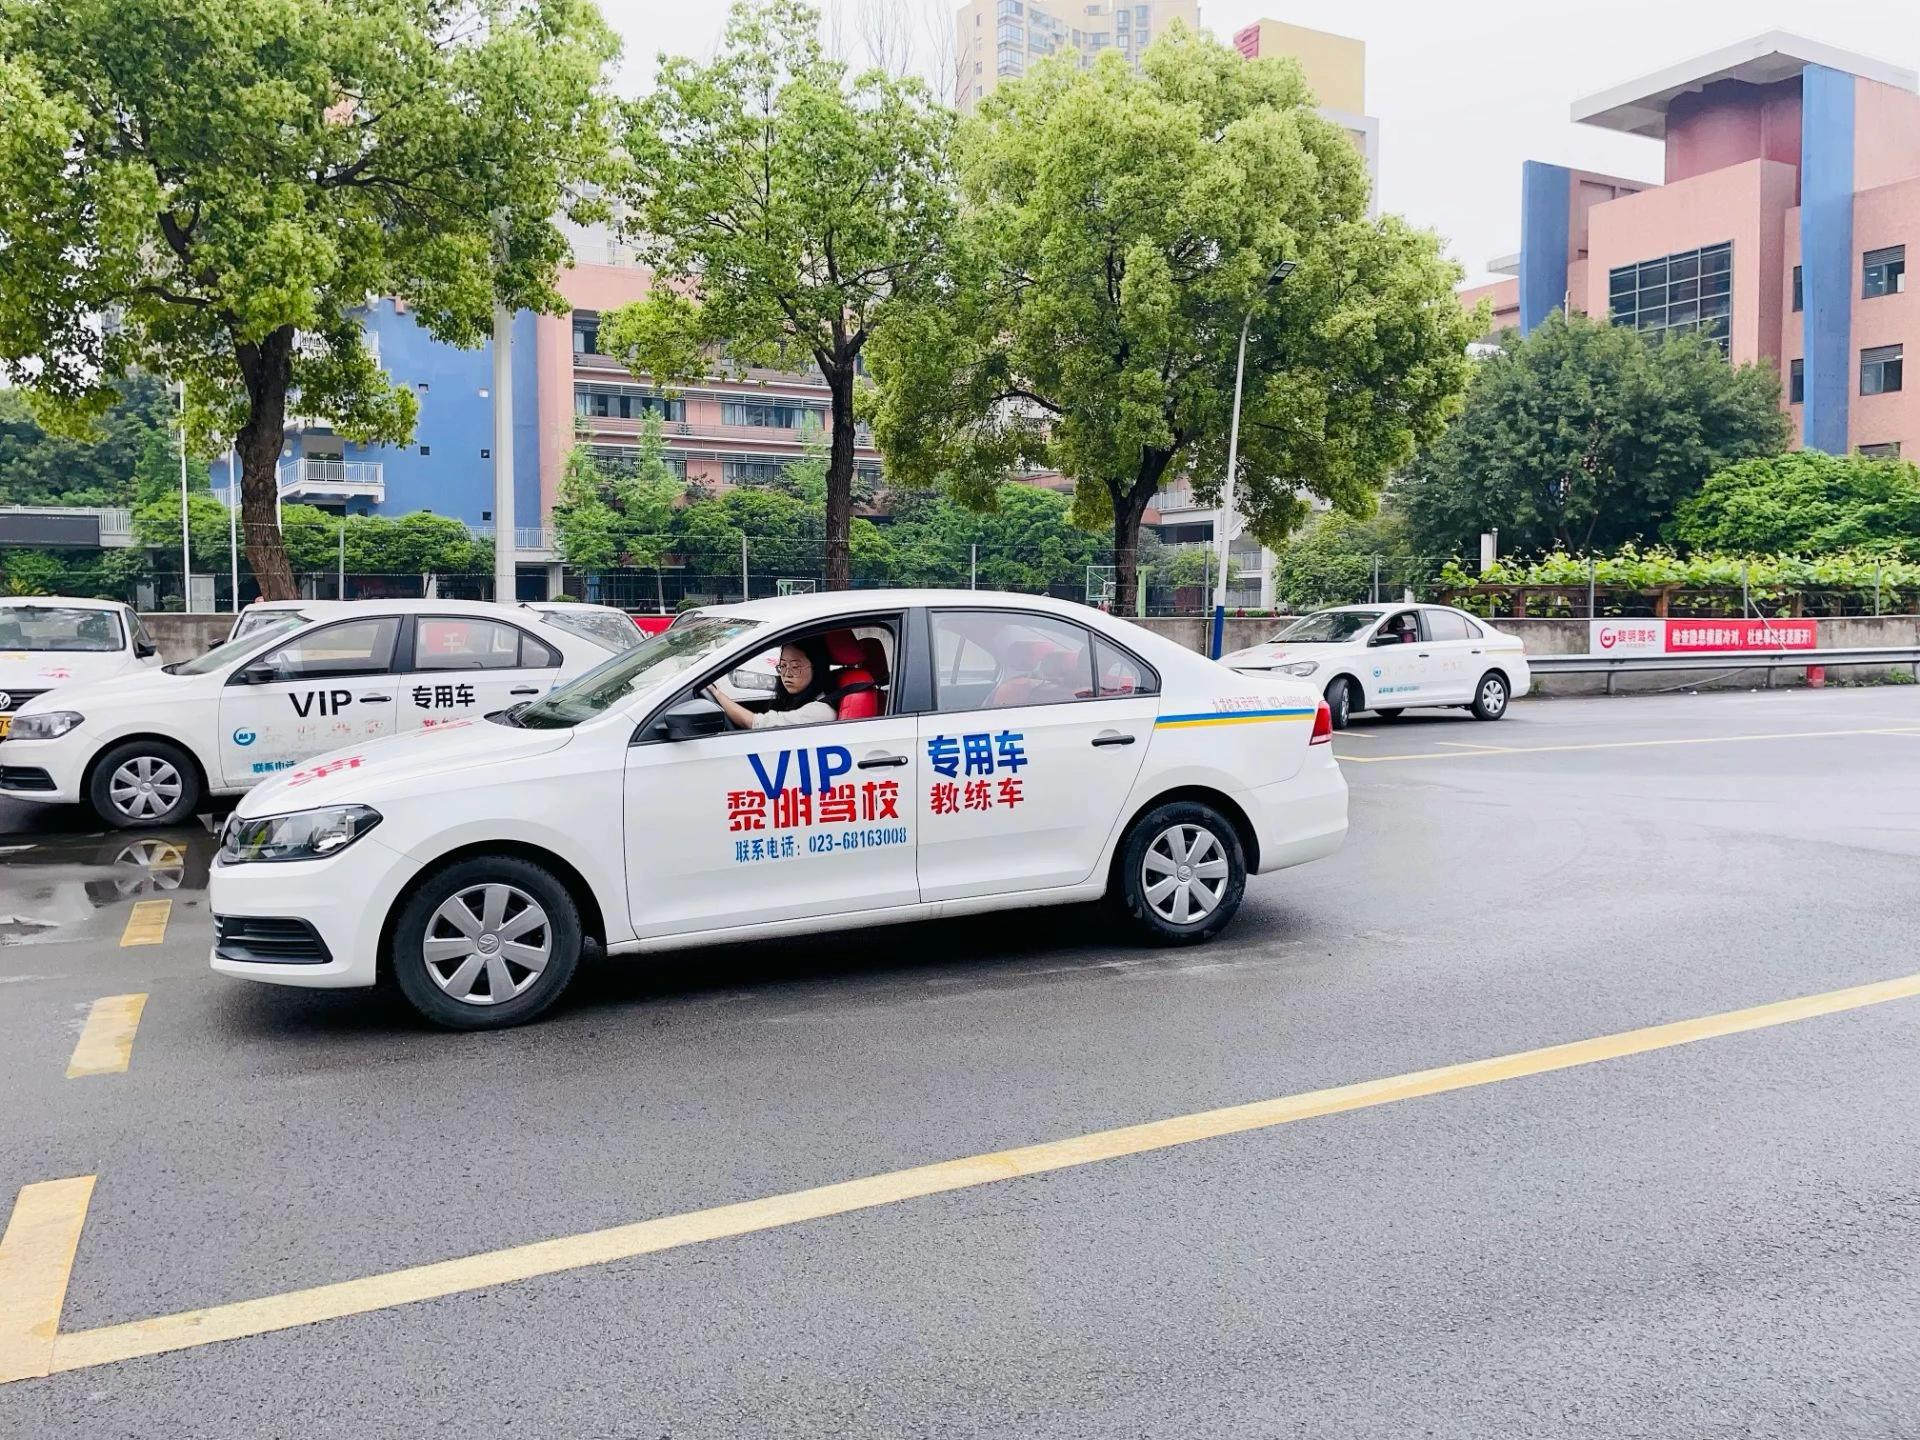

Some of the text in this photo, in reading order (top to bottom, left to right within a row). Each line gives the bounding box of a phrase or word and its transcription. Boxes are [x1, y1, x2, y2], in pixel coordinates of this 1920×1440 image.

[289, 684, 475, 717] VIP 专用车
[747, 730, 1028, 799] VIP 专用车
[727, 777, 1024, 831] 黎明驾校 教练车
[808, 827, 907, 853] 023-68163008
